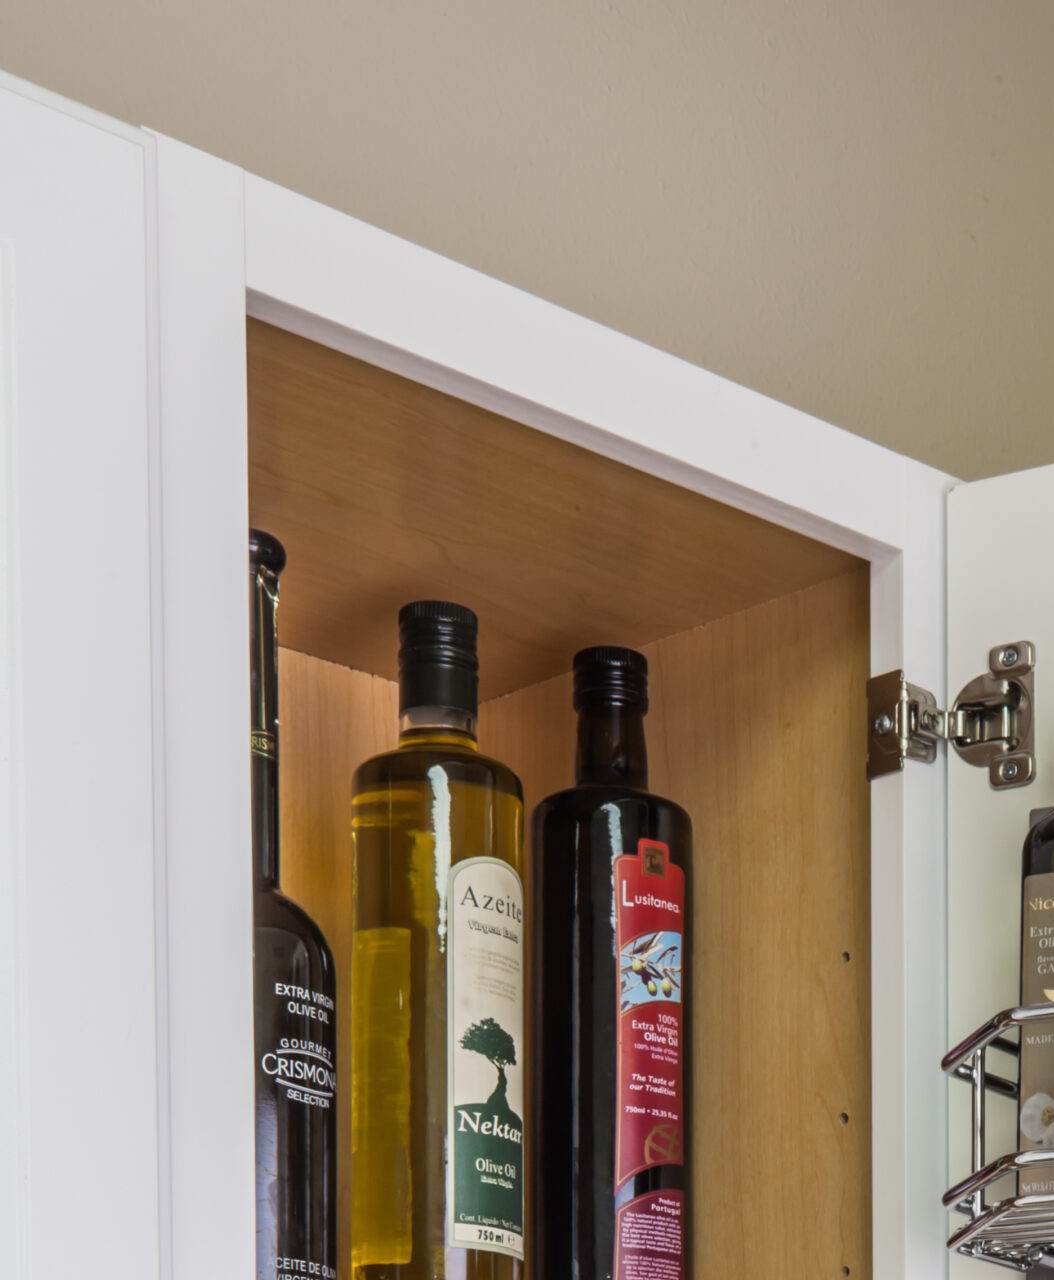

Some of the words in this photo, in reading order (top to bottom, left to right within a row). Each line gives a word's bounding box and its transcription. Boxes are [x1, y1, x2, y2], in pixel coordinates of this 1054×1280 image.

[460, 885, 523, 924] Azeite
[275, 982, 310, 1001] EXTRA
[312, 991, 334, 1011] VIRGIN
[288, 1001, 316, 1019] OLIVE
[318, 1010, 329, 1024] OIL
[658, 1014, 678, 1027] 100%
[632, 1020, 655, 1032] Extra
[656, 1023, 678, 1038] Virgin
[644, 1032, 667, 1045] Olive
[668, 1036, 678, 1048] Oil
[1026, 1033, 1053, 1046] MADE
[280, 1038, 332, 1060] GOURMET
[632, 1073, 646, 1083] The
[648, 1076, 667, 1086] Taste
[668, 1080, 676, 1088] of
[287, 1089, 330, 1109] SELECTION
[630, 1083, 644, 1091] our
[645, 1084, 676, 1098] Tradition
[457, 1110, 522, 1145] Nektar
[475, 1157, 504, 1176] Olive
[504, 1163, 516, 1180] Oil
[651, 1204, 681, 1216] Portugal
[478, 1230, 494, 1241] 750
[495, 1234, 504, 1244] ml
[309, 1261, 321, 1275] DE
